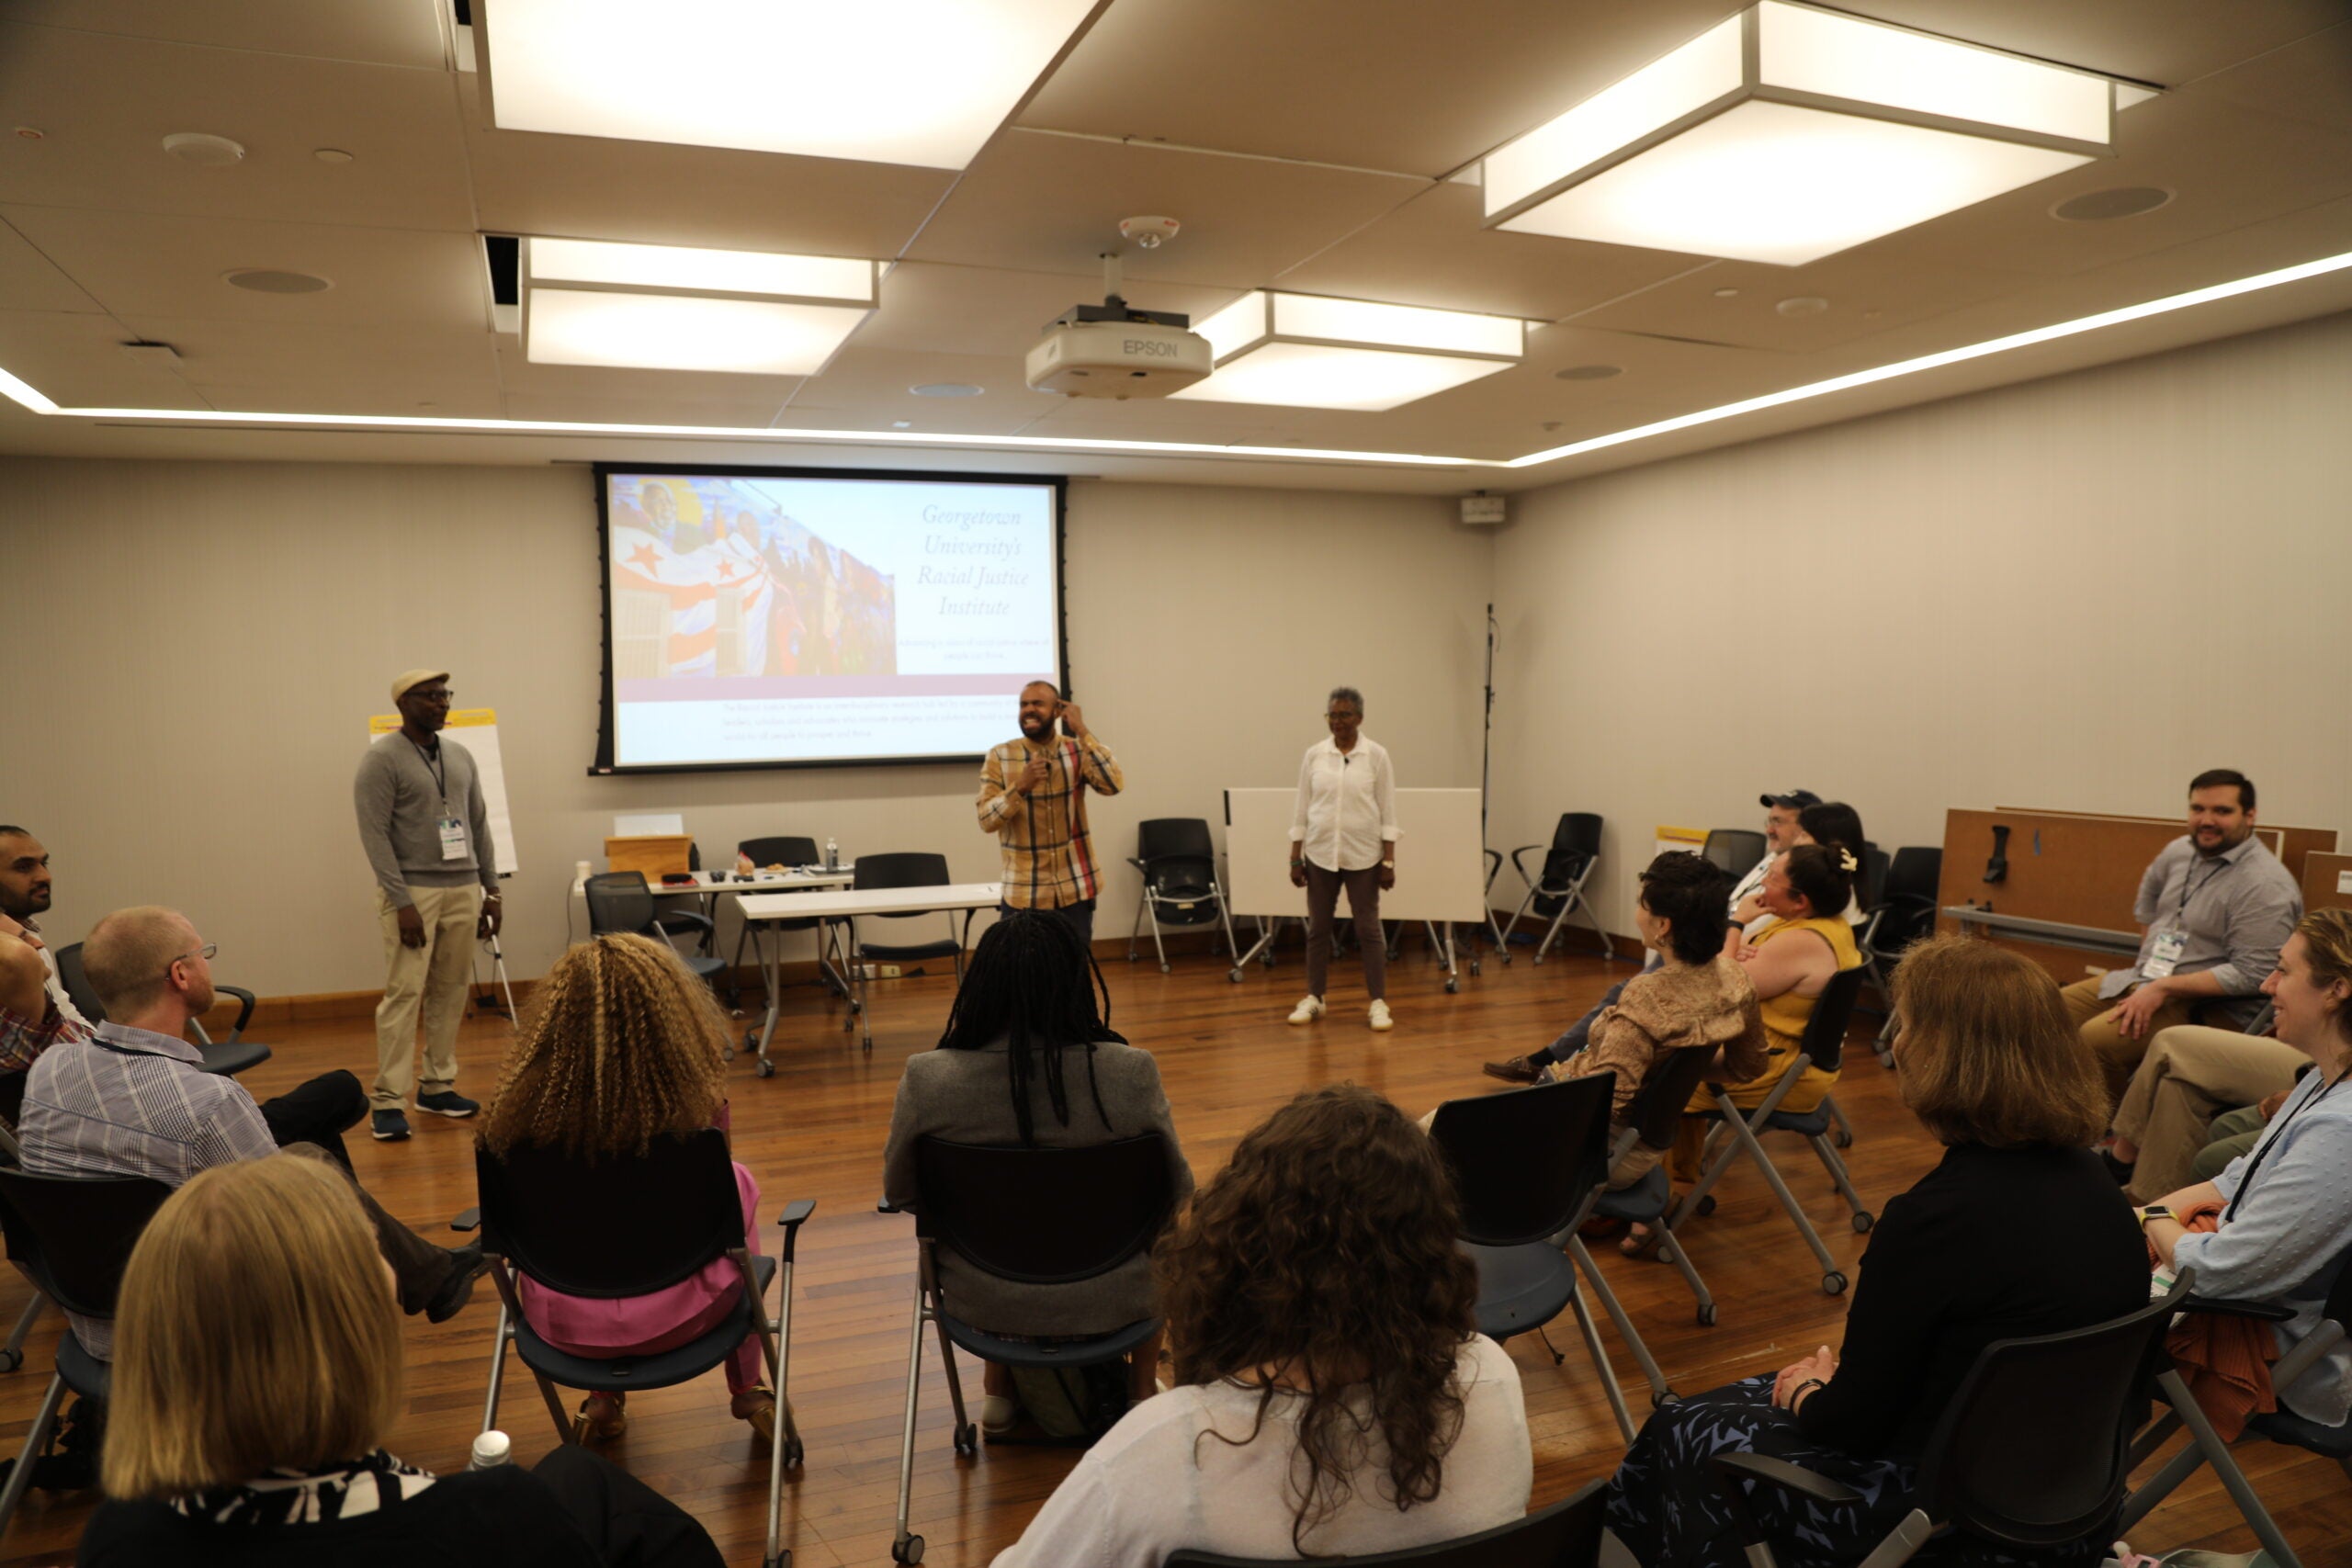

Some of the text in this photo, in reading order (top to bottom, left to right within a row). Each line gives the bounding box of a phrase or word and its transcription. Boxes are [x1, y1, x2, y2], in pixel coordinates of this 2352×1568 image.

[1123, 339, 1178, 357] EPSON
[922, 503, 1021, 531] Georgetown
[924, 535, 1022, 562] University's
[917, 565, 1029, 589] Racial Justice
[937, 595, 1010, 616] Institute
